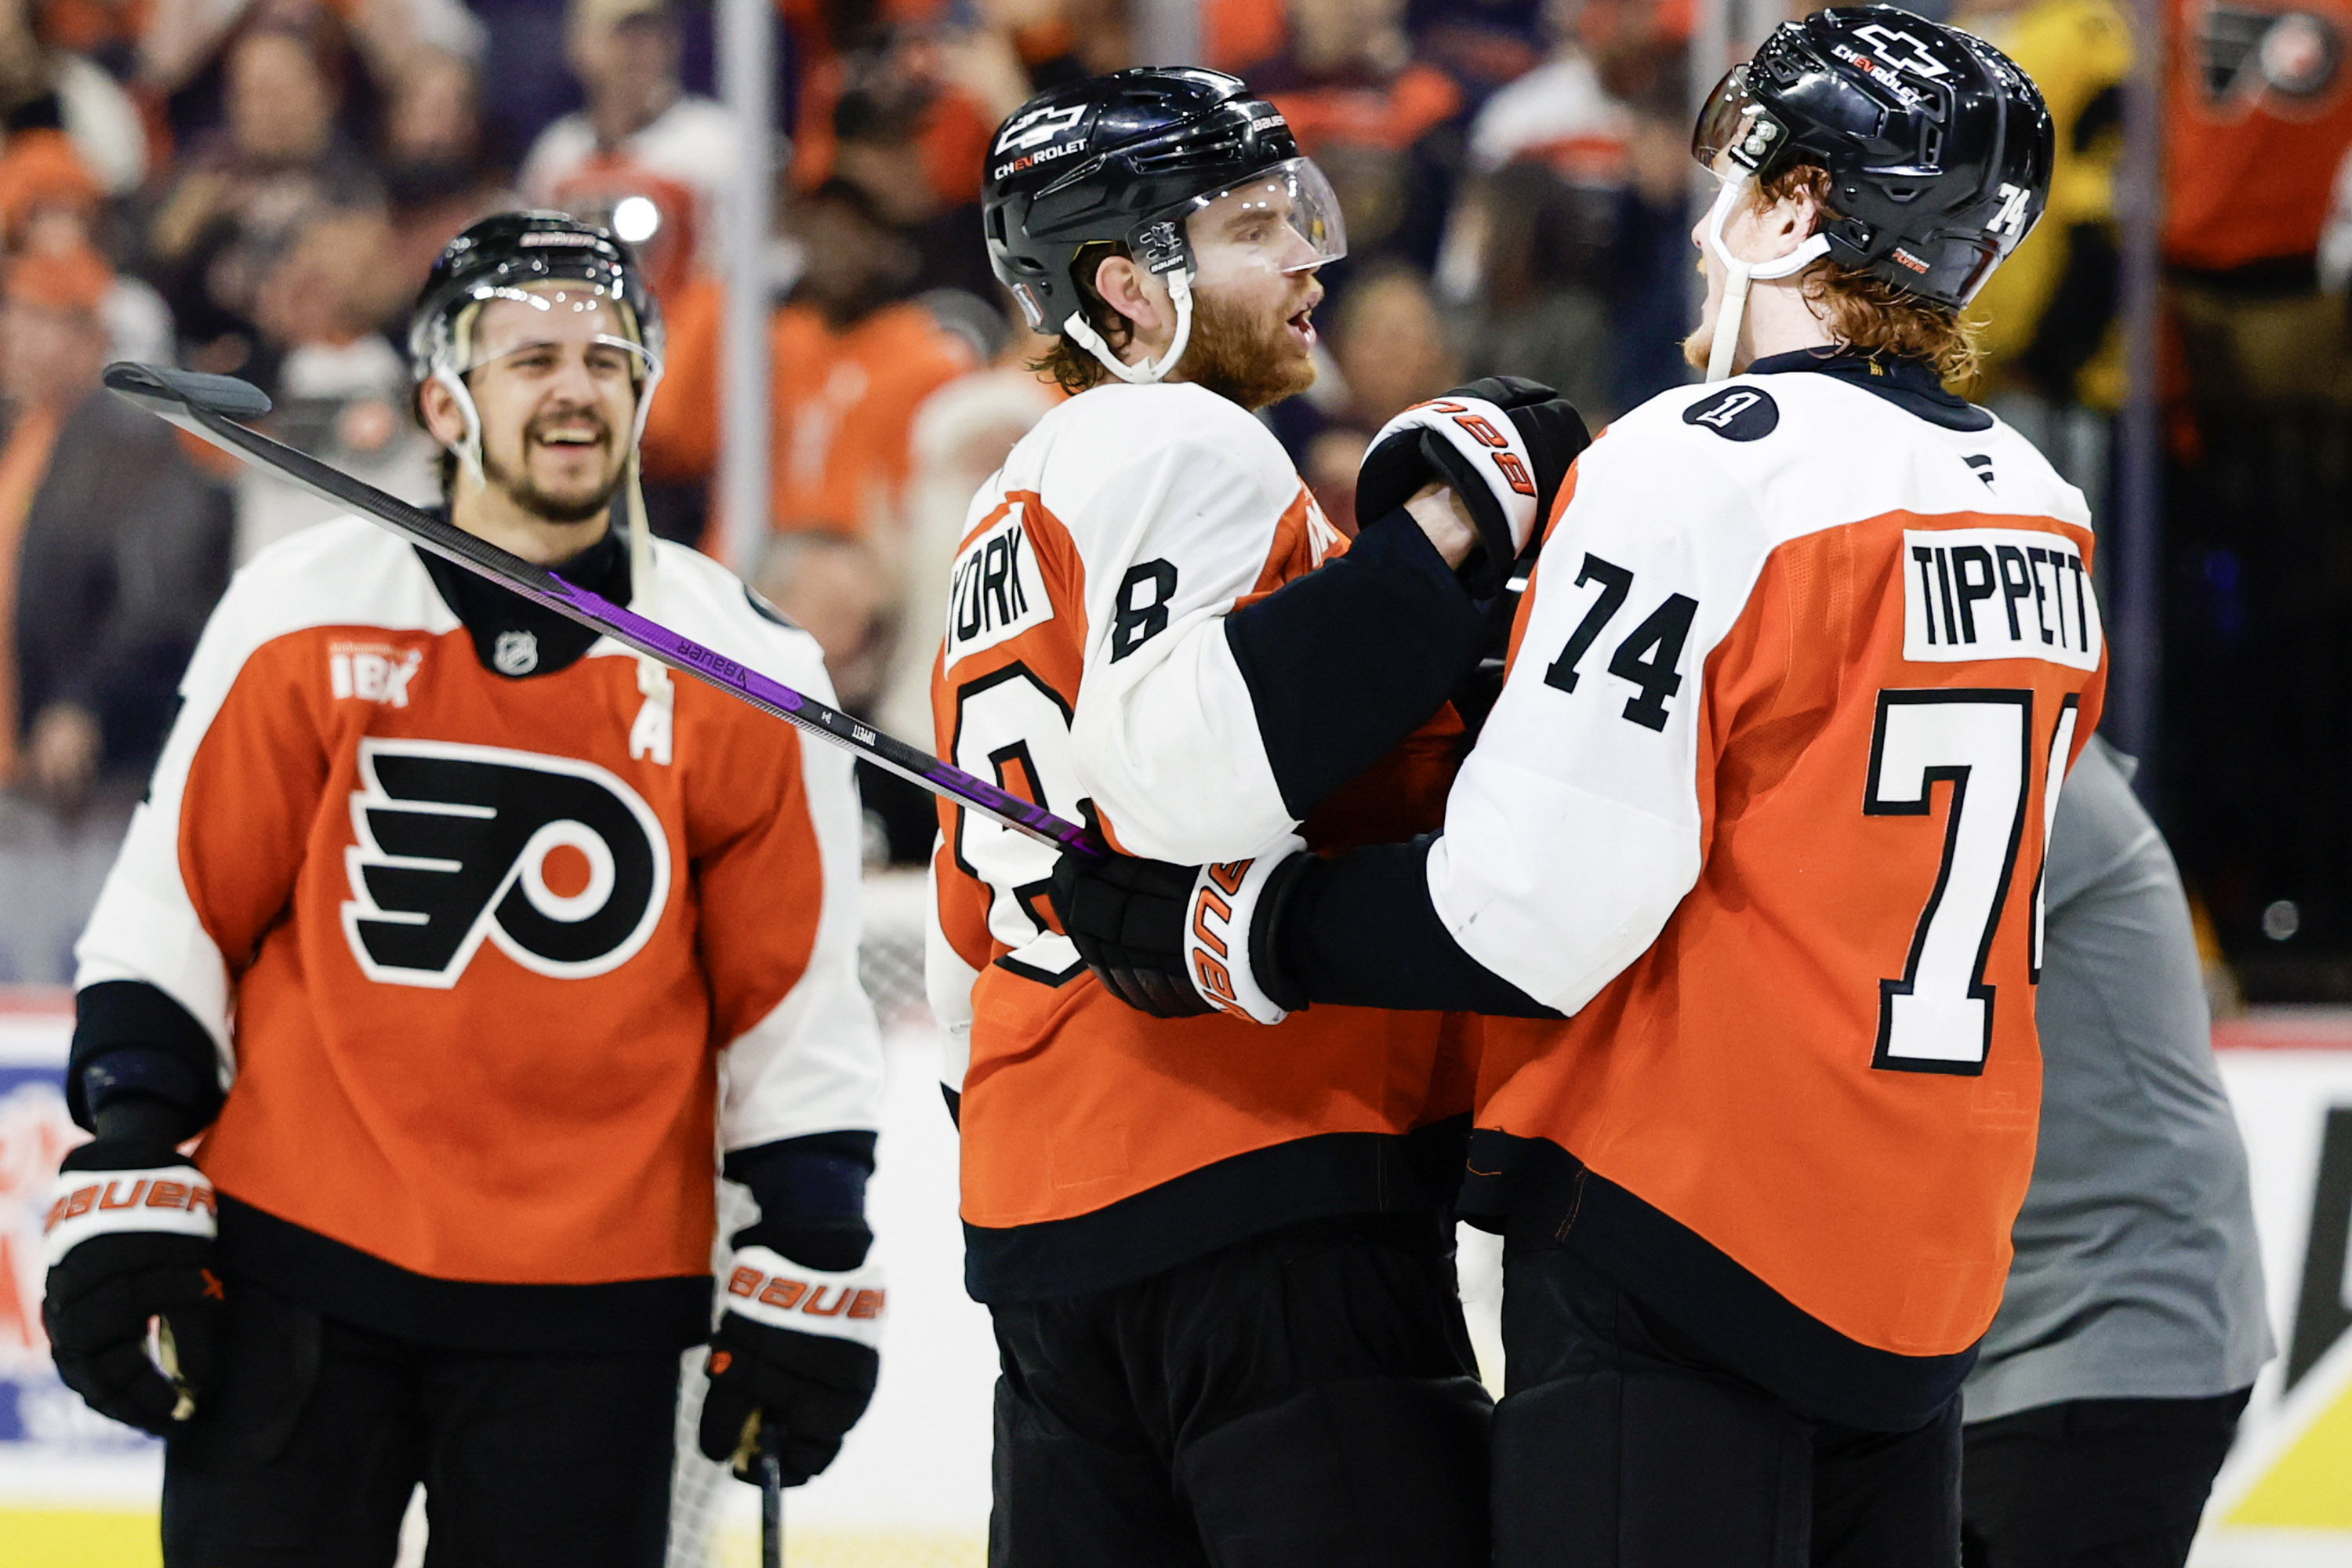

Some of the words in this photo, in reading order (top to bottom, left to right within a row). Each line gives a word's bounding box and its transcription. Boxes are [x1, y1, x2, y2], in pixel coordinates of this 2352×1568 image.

[994, 138, 1087, 180] CHEVROLET
[1985, 182, 2031, 236] 74
[947, 524, 1029, 656] YORK
[1109, 557, 1178, 665] 8
[1543, 552, 1700, 733] 74
[1911, 545, 2088, 653] TIPPETT
[1862, 688, 2080, 1076] 7
[728, 1265, 886, 1319] BAUE
